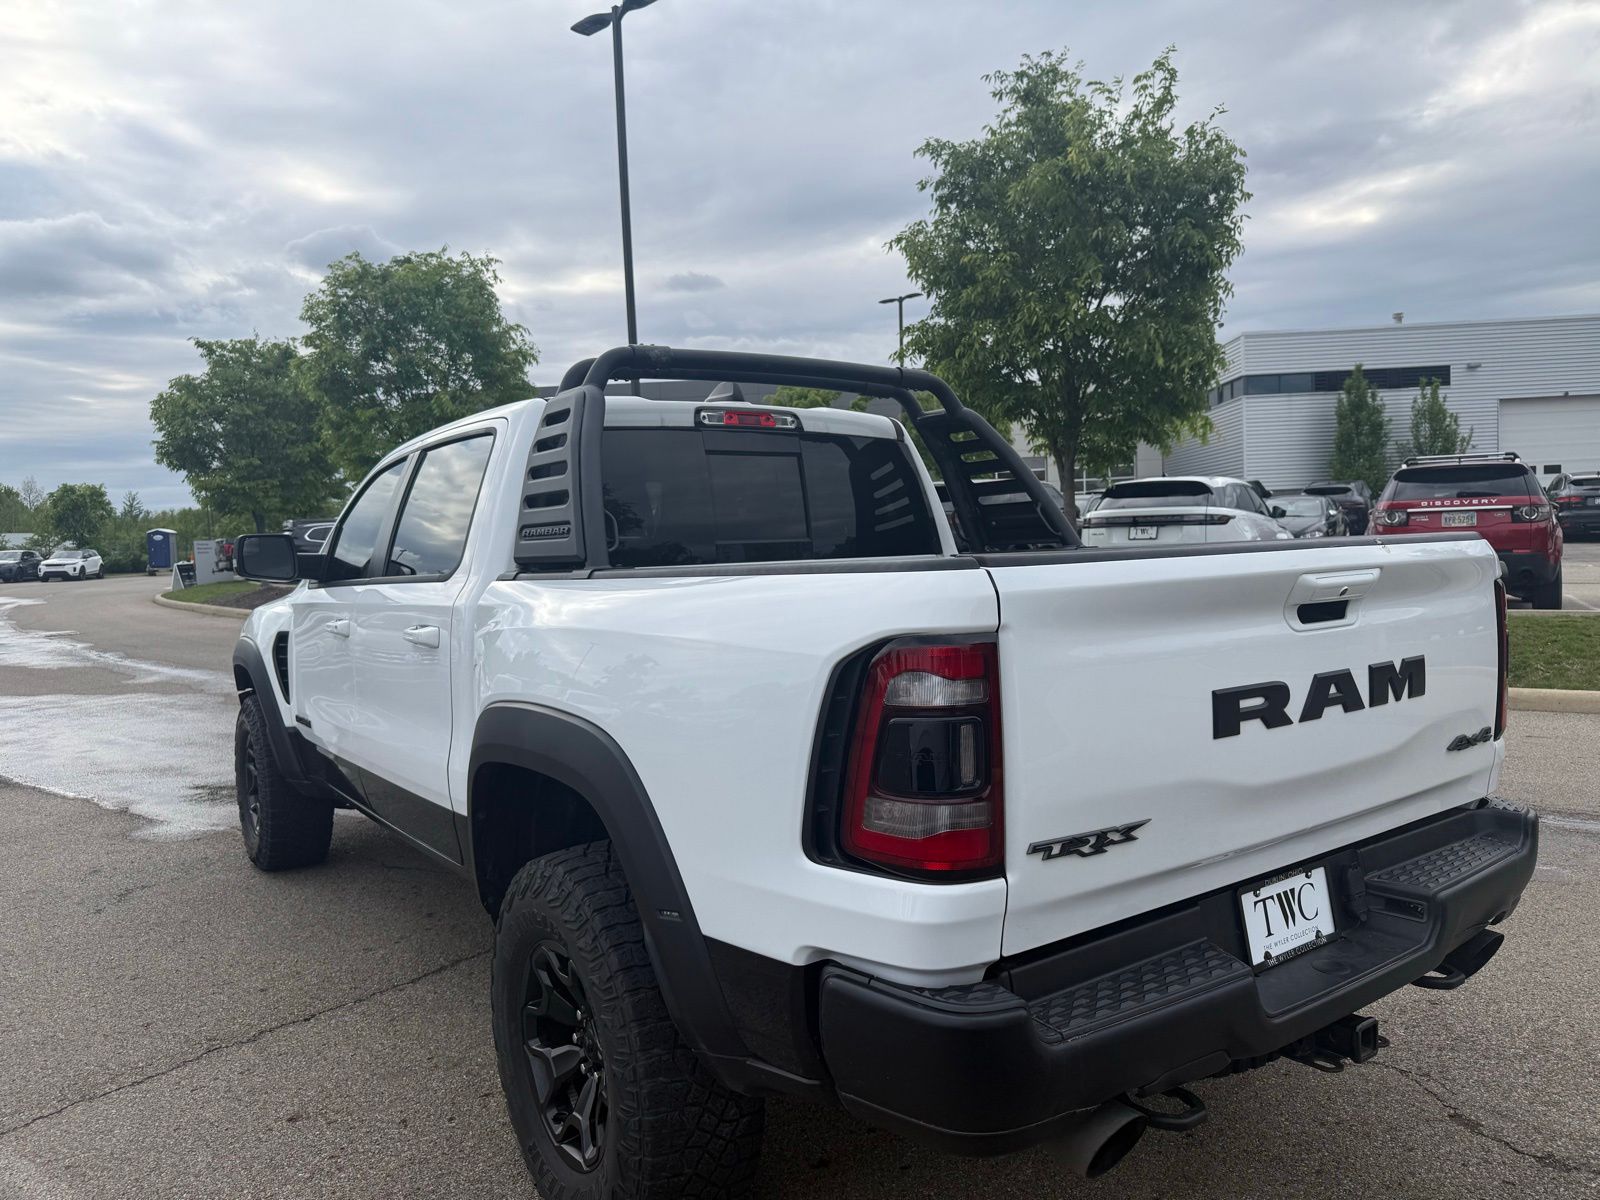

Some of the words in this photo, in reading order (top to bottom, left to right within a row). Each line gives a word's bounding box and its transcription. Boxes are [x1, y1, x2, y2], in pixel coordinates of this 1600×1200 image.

[1421, 499, 1498, 507] DISCOVERY
[522, 526, 568, 537] RAMBAR
[1212, 654, 1425, 740] RAM
[1026, 818, 1152, 861] TRX
[1253, 882, 1319, 938] TWC
[1263, 942, 1273, 950] THE
[1274, 937, 1290, 948] WYLER
[1289, 925, 1319, 941] COLLECTION
[1267, 957, 1278, 967] THE
[1277, 950, 1295, 961] WYLER
[1295, 937, 1328, 955] COLLECTION
